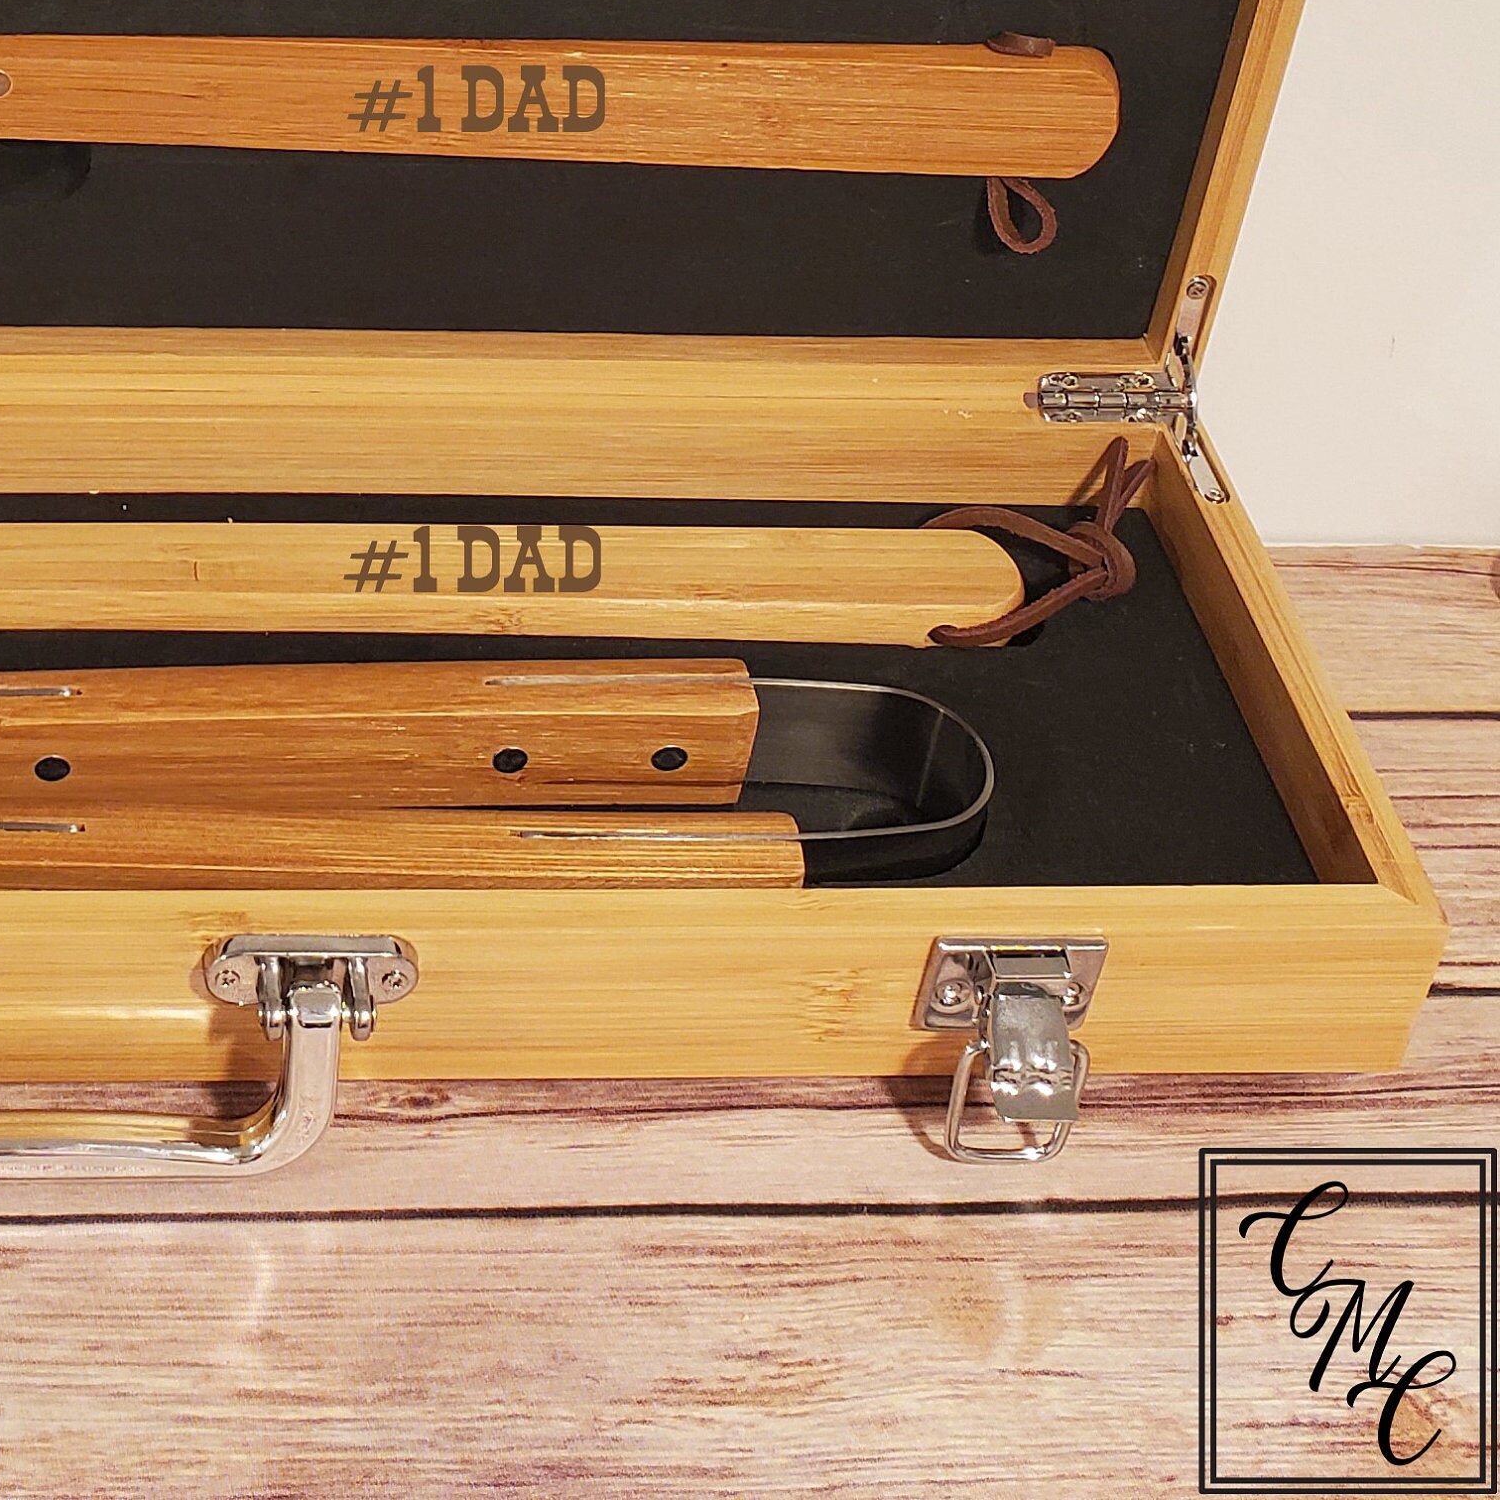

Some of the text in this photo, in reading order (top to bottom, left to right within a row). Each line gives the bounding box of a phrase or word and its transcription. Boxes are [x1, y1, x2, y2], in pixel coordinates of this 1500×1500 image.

[347, 65, 605, 132] #1 DAD
[343, 526, 601, 592] #1 DAD
